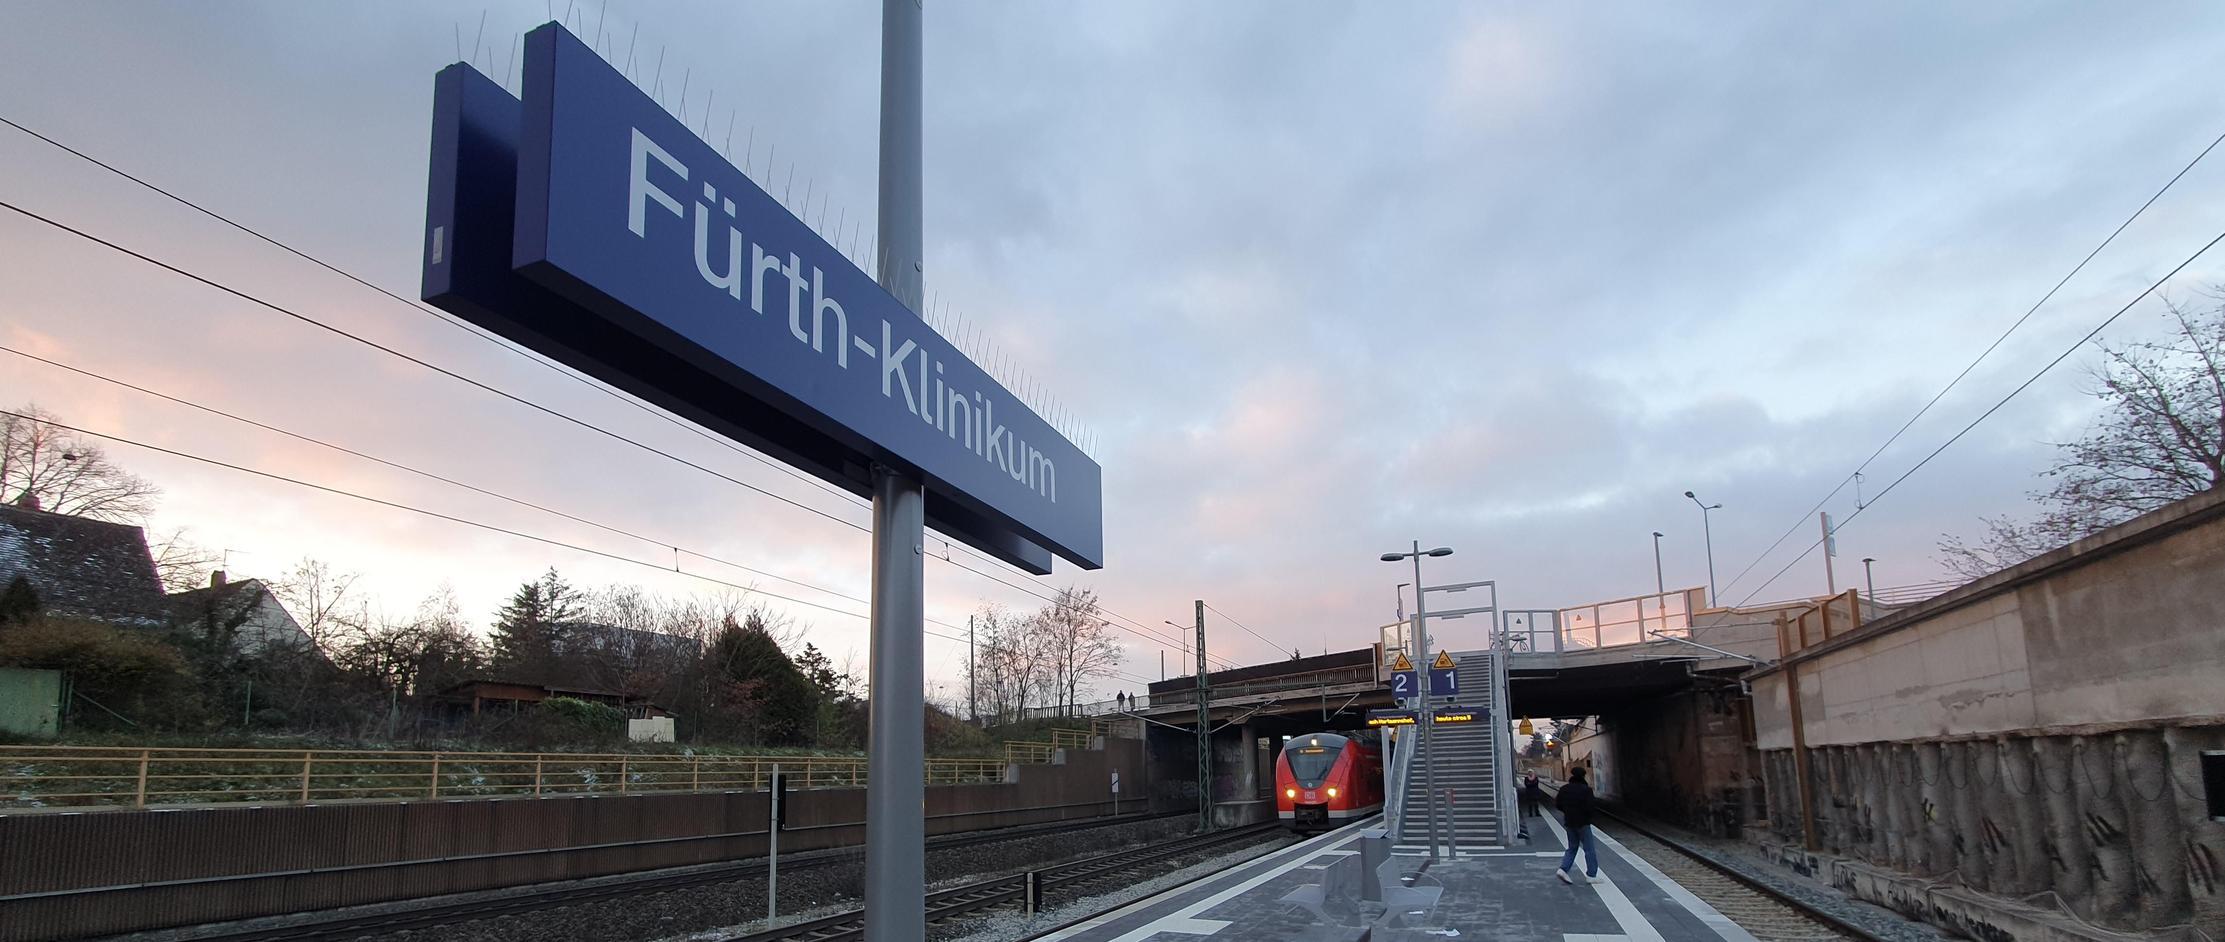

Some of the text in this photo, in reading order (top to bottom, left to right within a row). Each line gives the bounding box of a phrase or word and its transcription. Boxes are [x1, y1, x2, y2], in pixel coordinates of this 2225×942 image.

[628, 127, 1057, 505] Fürth-Klinikum
[1395, 674, 1408, 692] 2
[1446, 671, 1455, 689] 1
